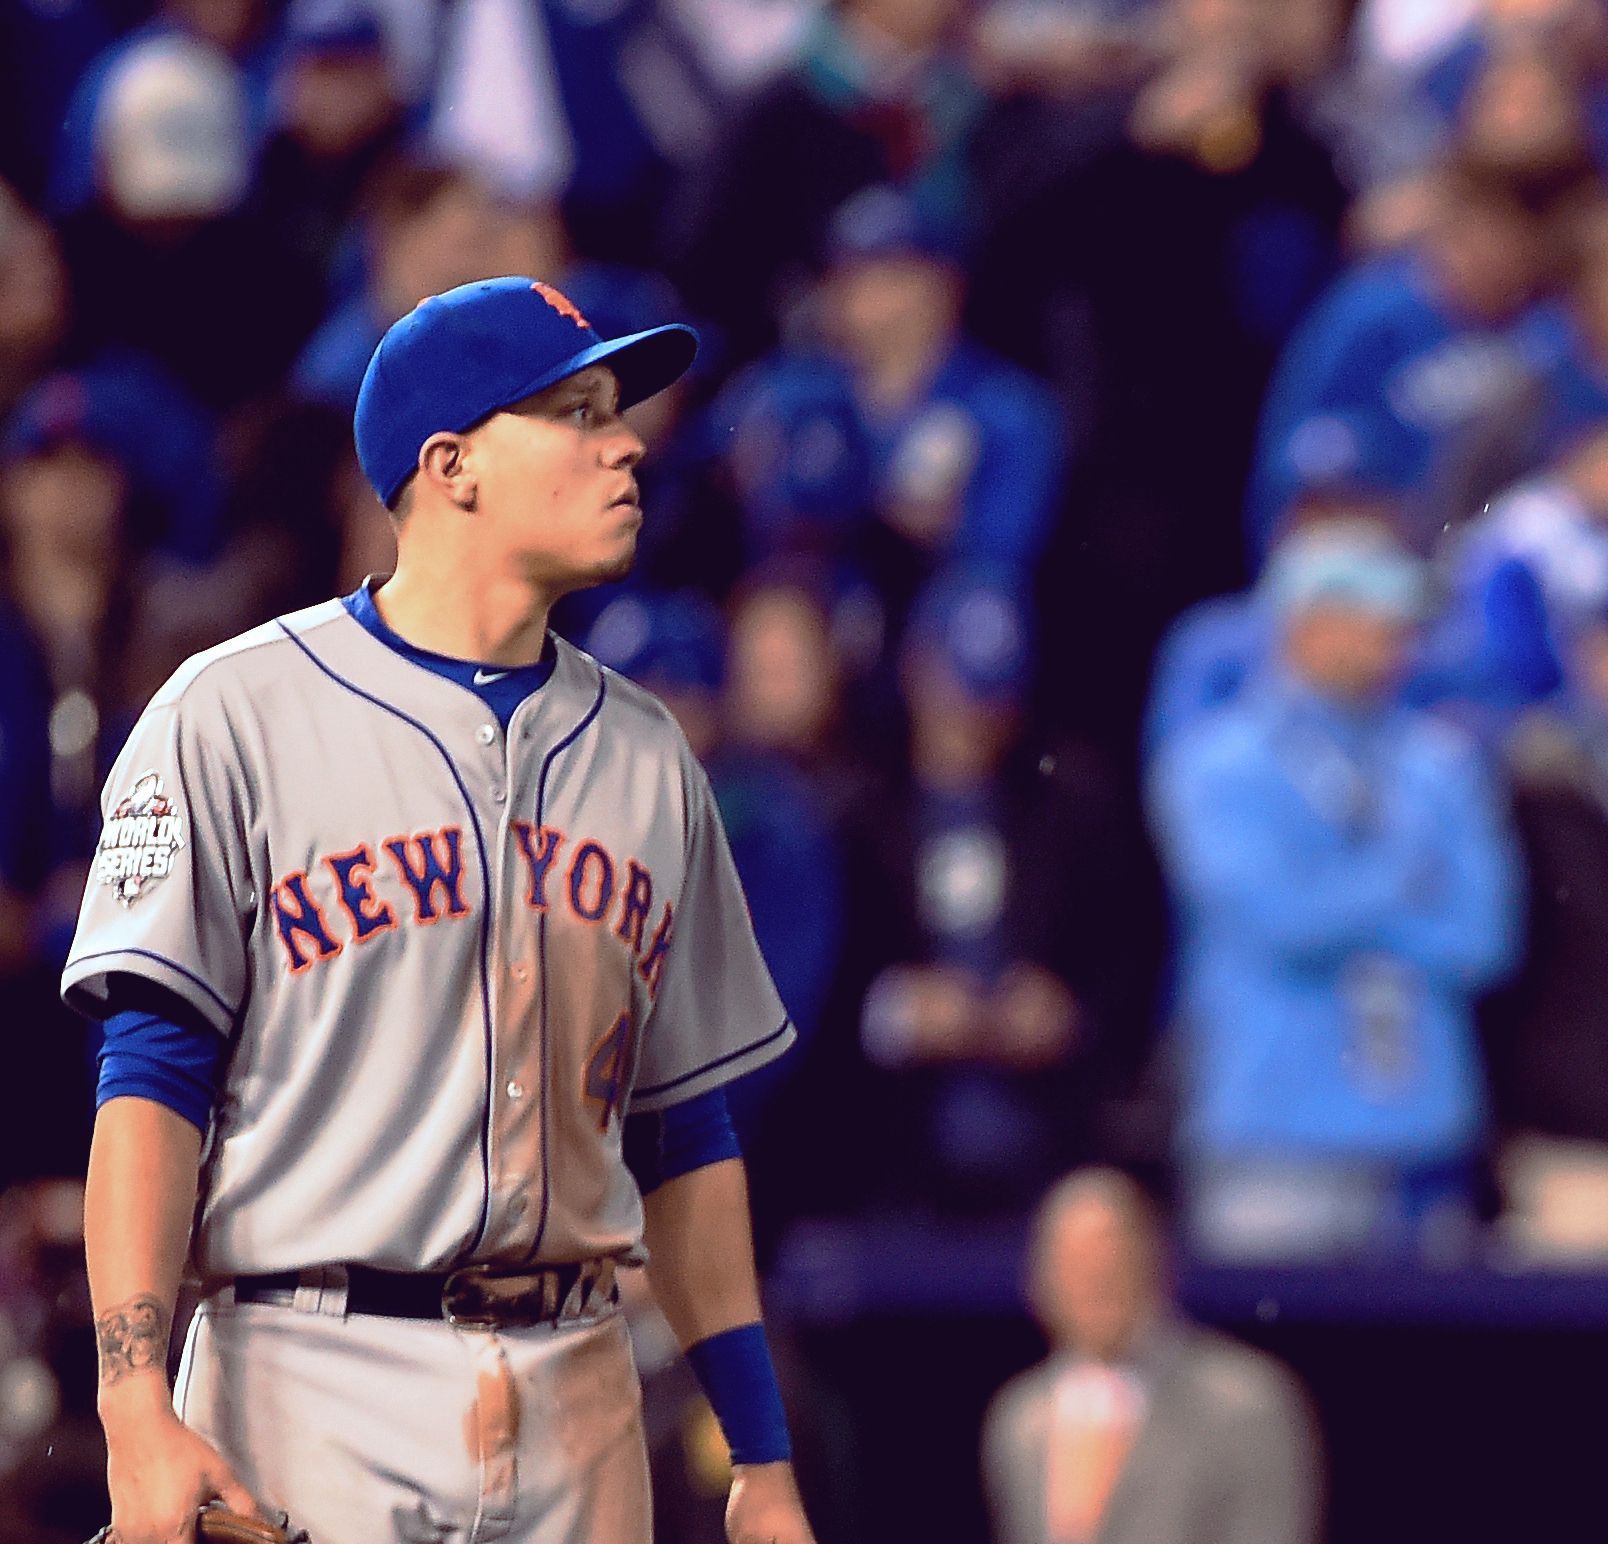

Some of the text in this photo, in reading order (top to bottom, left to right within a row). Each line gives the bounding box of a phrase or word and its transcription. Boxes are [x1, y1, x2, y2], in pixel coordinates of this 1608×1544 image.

[98, 848, 171, 878] SERIES
[102, 815, 173, 848] WORLD
[271, 822, 471, 975] NEW
[582, 1008, 631, 1135] 4
